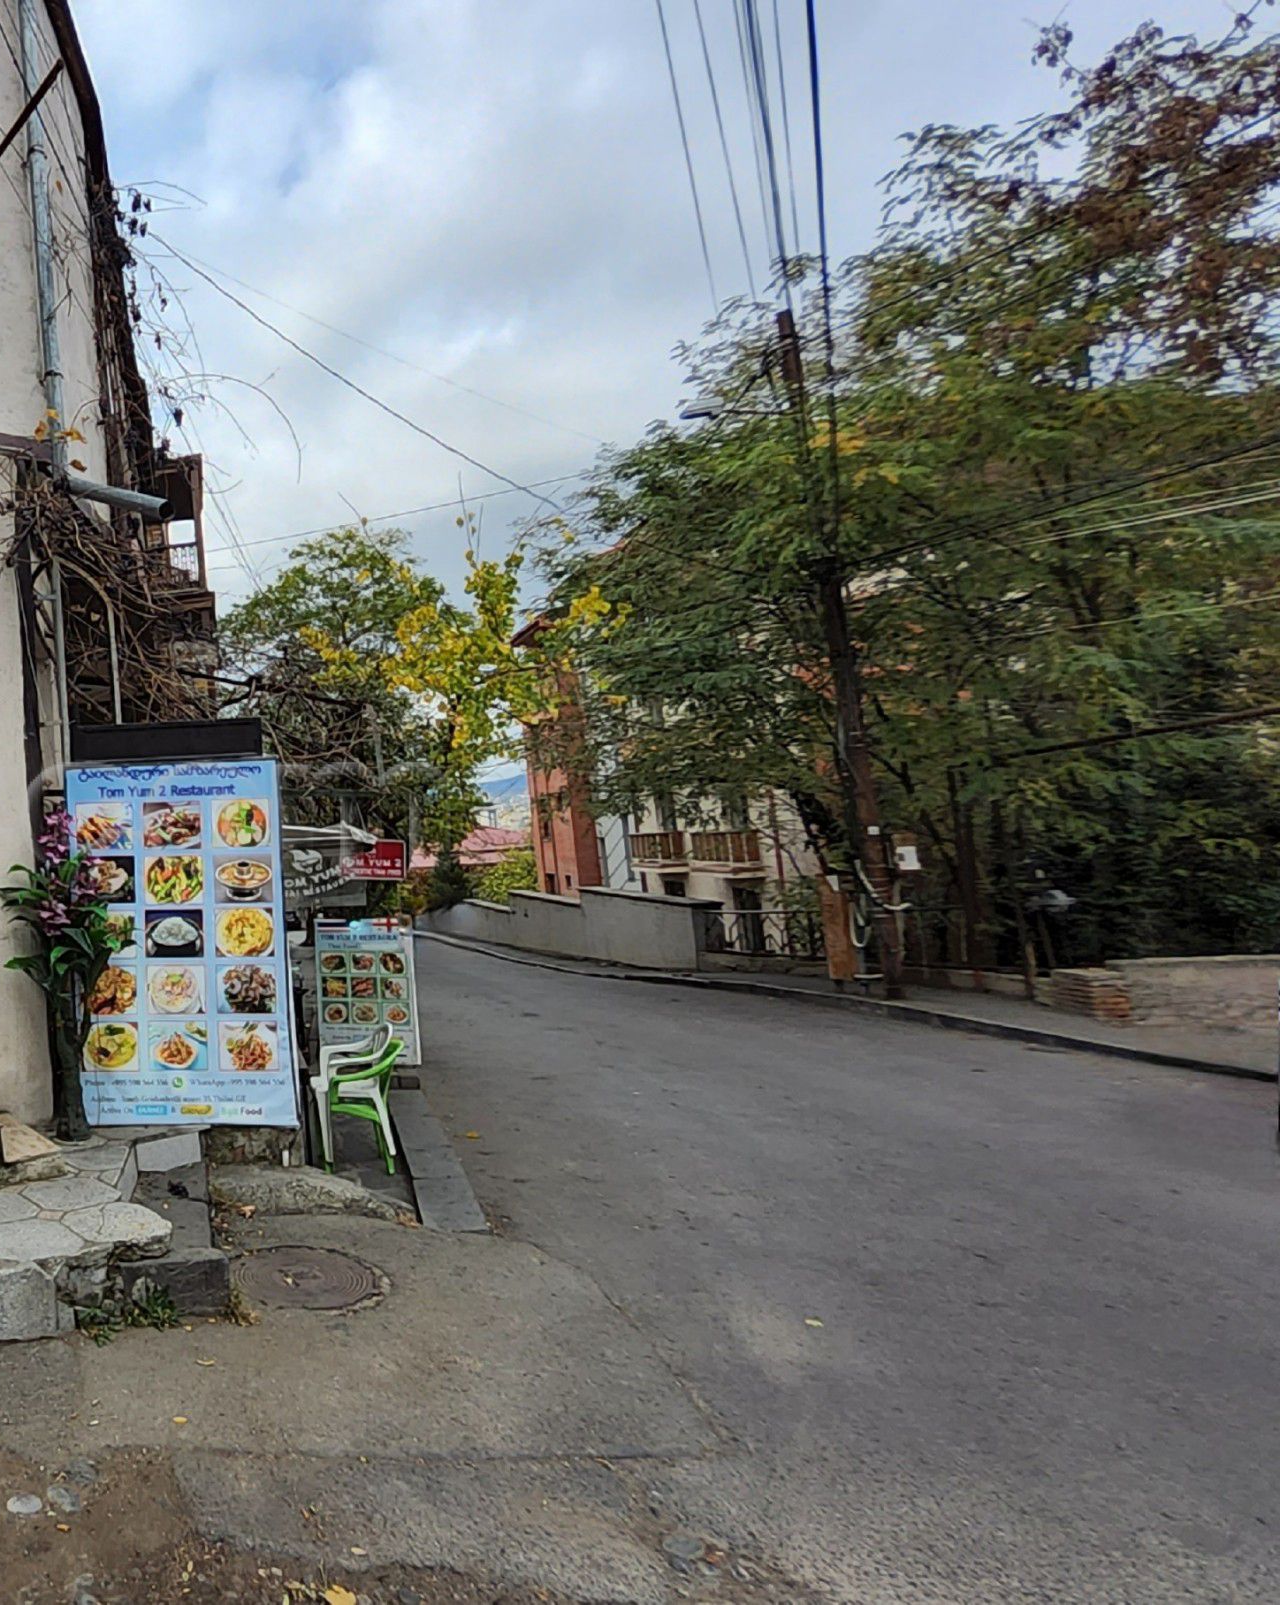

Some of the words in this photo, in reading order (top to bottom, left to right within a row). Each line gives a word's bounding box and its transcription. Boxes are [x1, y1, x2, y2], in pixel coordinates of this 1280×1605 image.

[98, 786, 125, 798] Tom
[128, 785, 155, 798] Yum
[159, 785, 167, 797] 2
[171, 784, 237, 797] Restaurant
[369, 859, 391, 867] YUM
[284, 876, 307, 888] OM
[240, 1106, 263, 1116] Food
